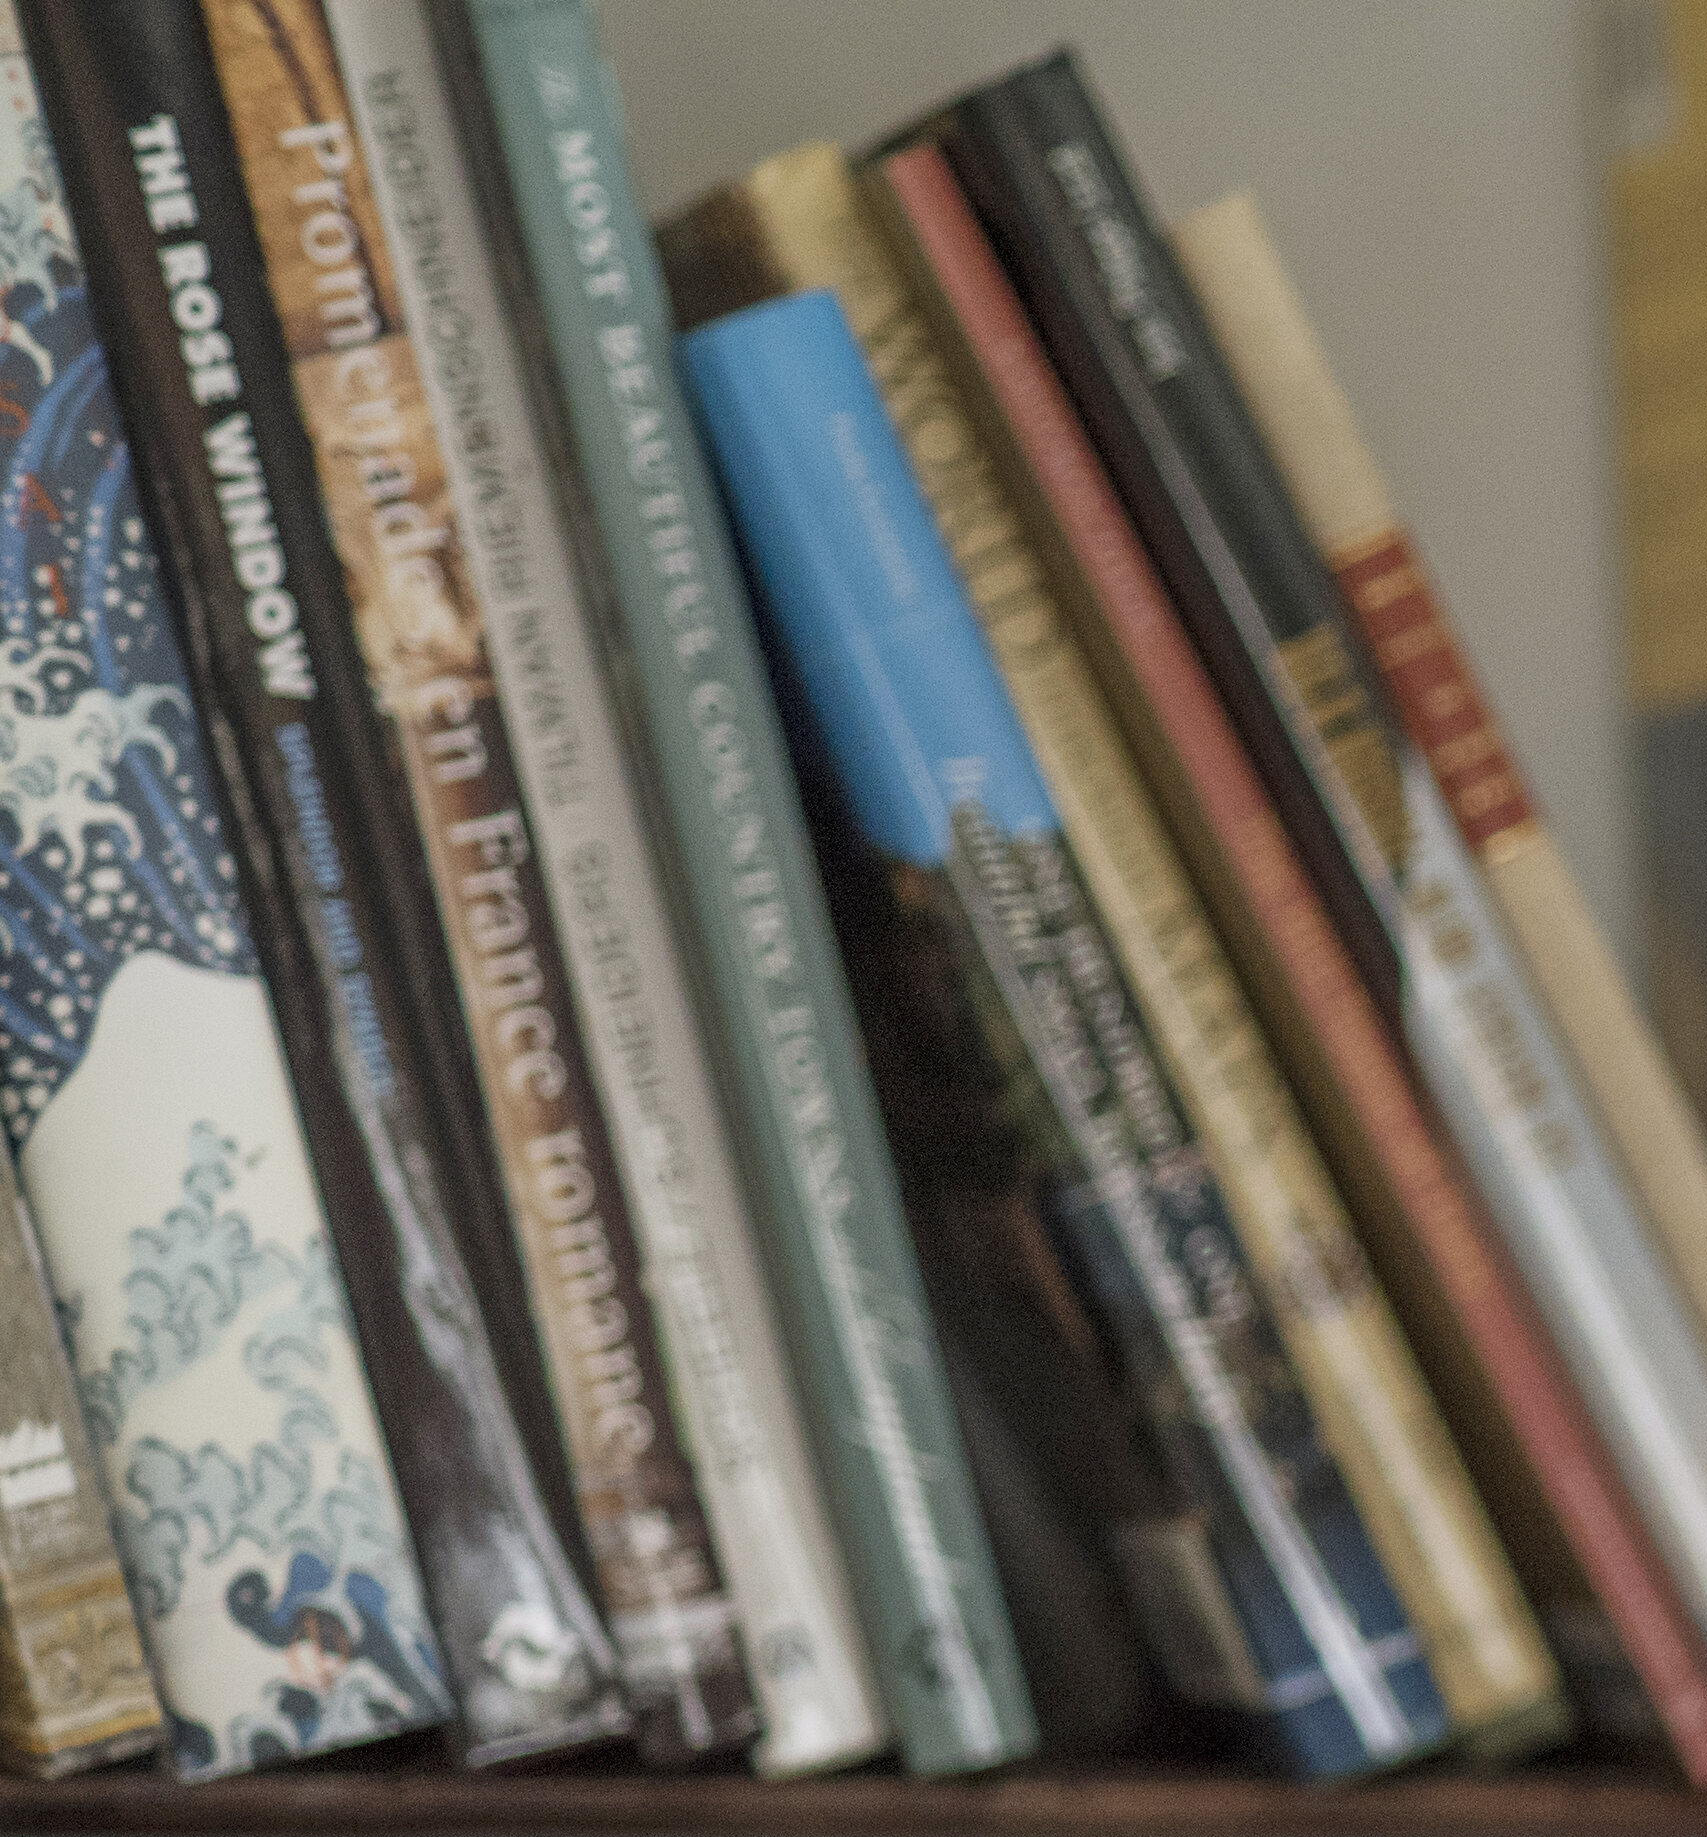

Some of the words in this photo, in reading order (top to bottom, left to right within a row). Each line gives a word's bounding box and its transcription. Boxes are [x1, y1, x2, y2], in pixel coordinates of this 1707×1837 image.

[124, 113, 203, 240] THE
[153, 238, 244, 408] ROSE
[260, 117, 473, 662] Promenades
[195, 413, 324, 712] WINDOW
[403, 671, 494, 789] en
[432, 804, 587, 1112] France
[515, 1125, 665, 1465] romane
